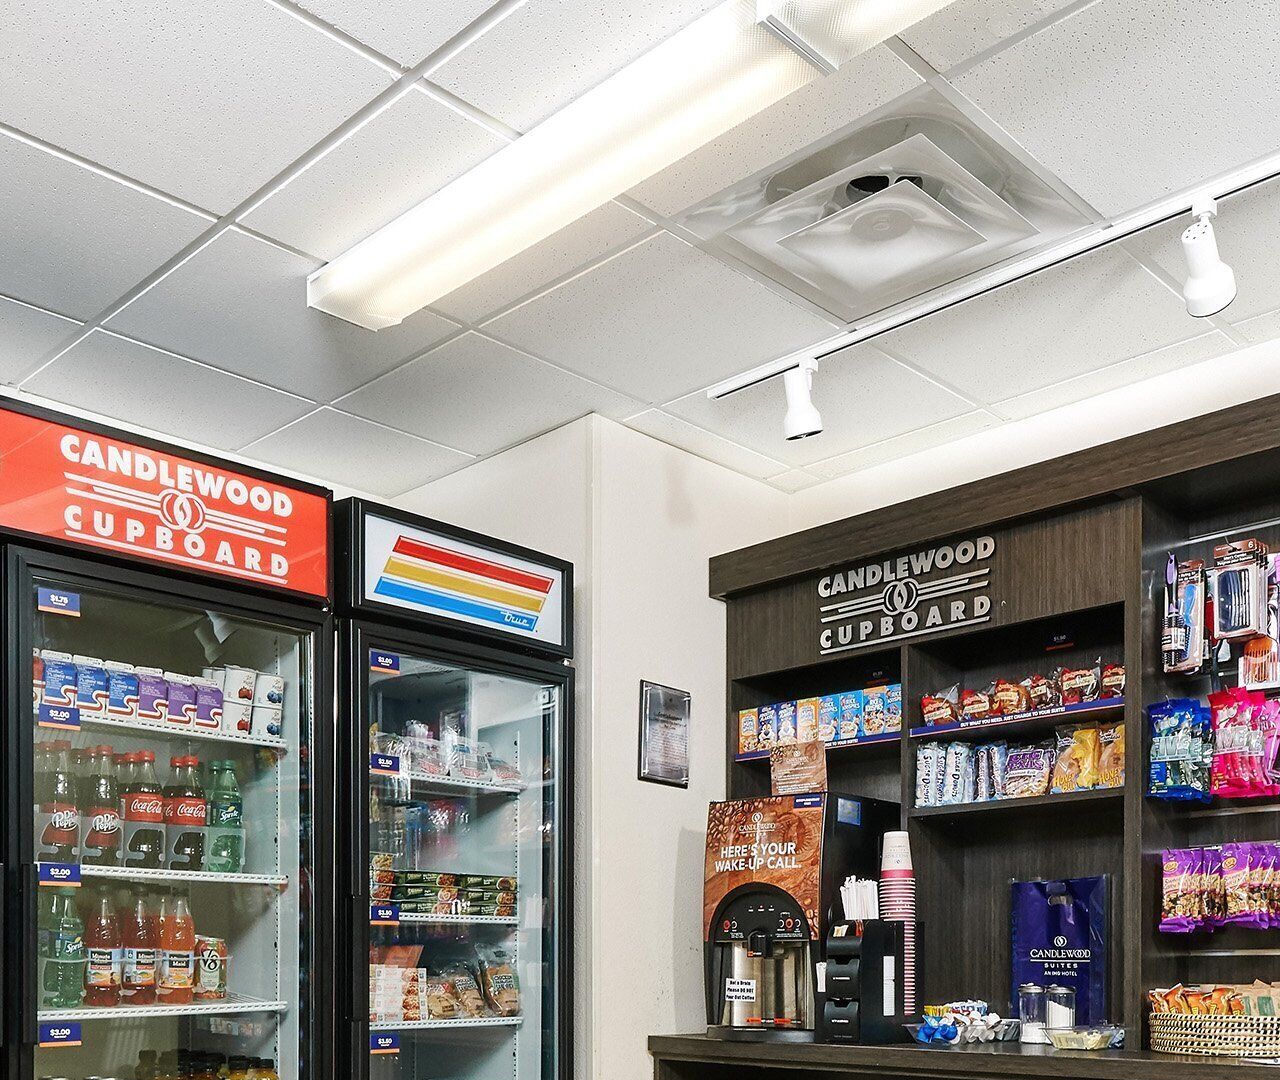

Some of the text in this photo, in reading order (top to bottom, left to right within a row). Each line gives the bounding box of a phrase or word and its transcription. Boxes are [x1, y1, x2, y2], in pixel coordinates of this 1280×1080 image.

[60, 435, 293, 518] CANDLEWOOD
[63, 506, 289, 577] CUPBOARD
[818, 536, 996, 599] CANDLEWOOD
[820, 595, 991, 649] CUPBOARD
[49, 710, 70, 718] $2.00
[1014, 712, 1032, 720] CHARGE
[721, 843, 795, 858] HERE'S YOUR
[50, 868, 70, 876] $2.00
[715, 857, 801, 872] WAKE-UP CALL.
[1030, 949, 1090, 958] CANDLEWOOD
[50, 1028, 70, 1036] $3.00
